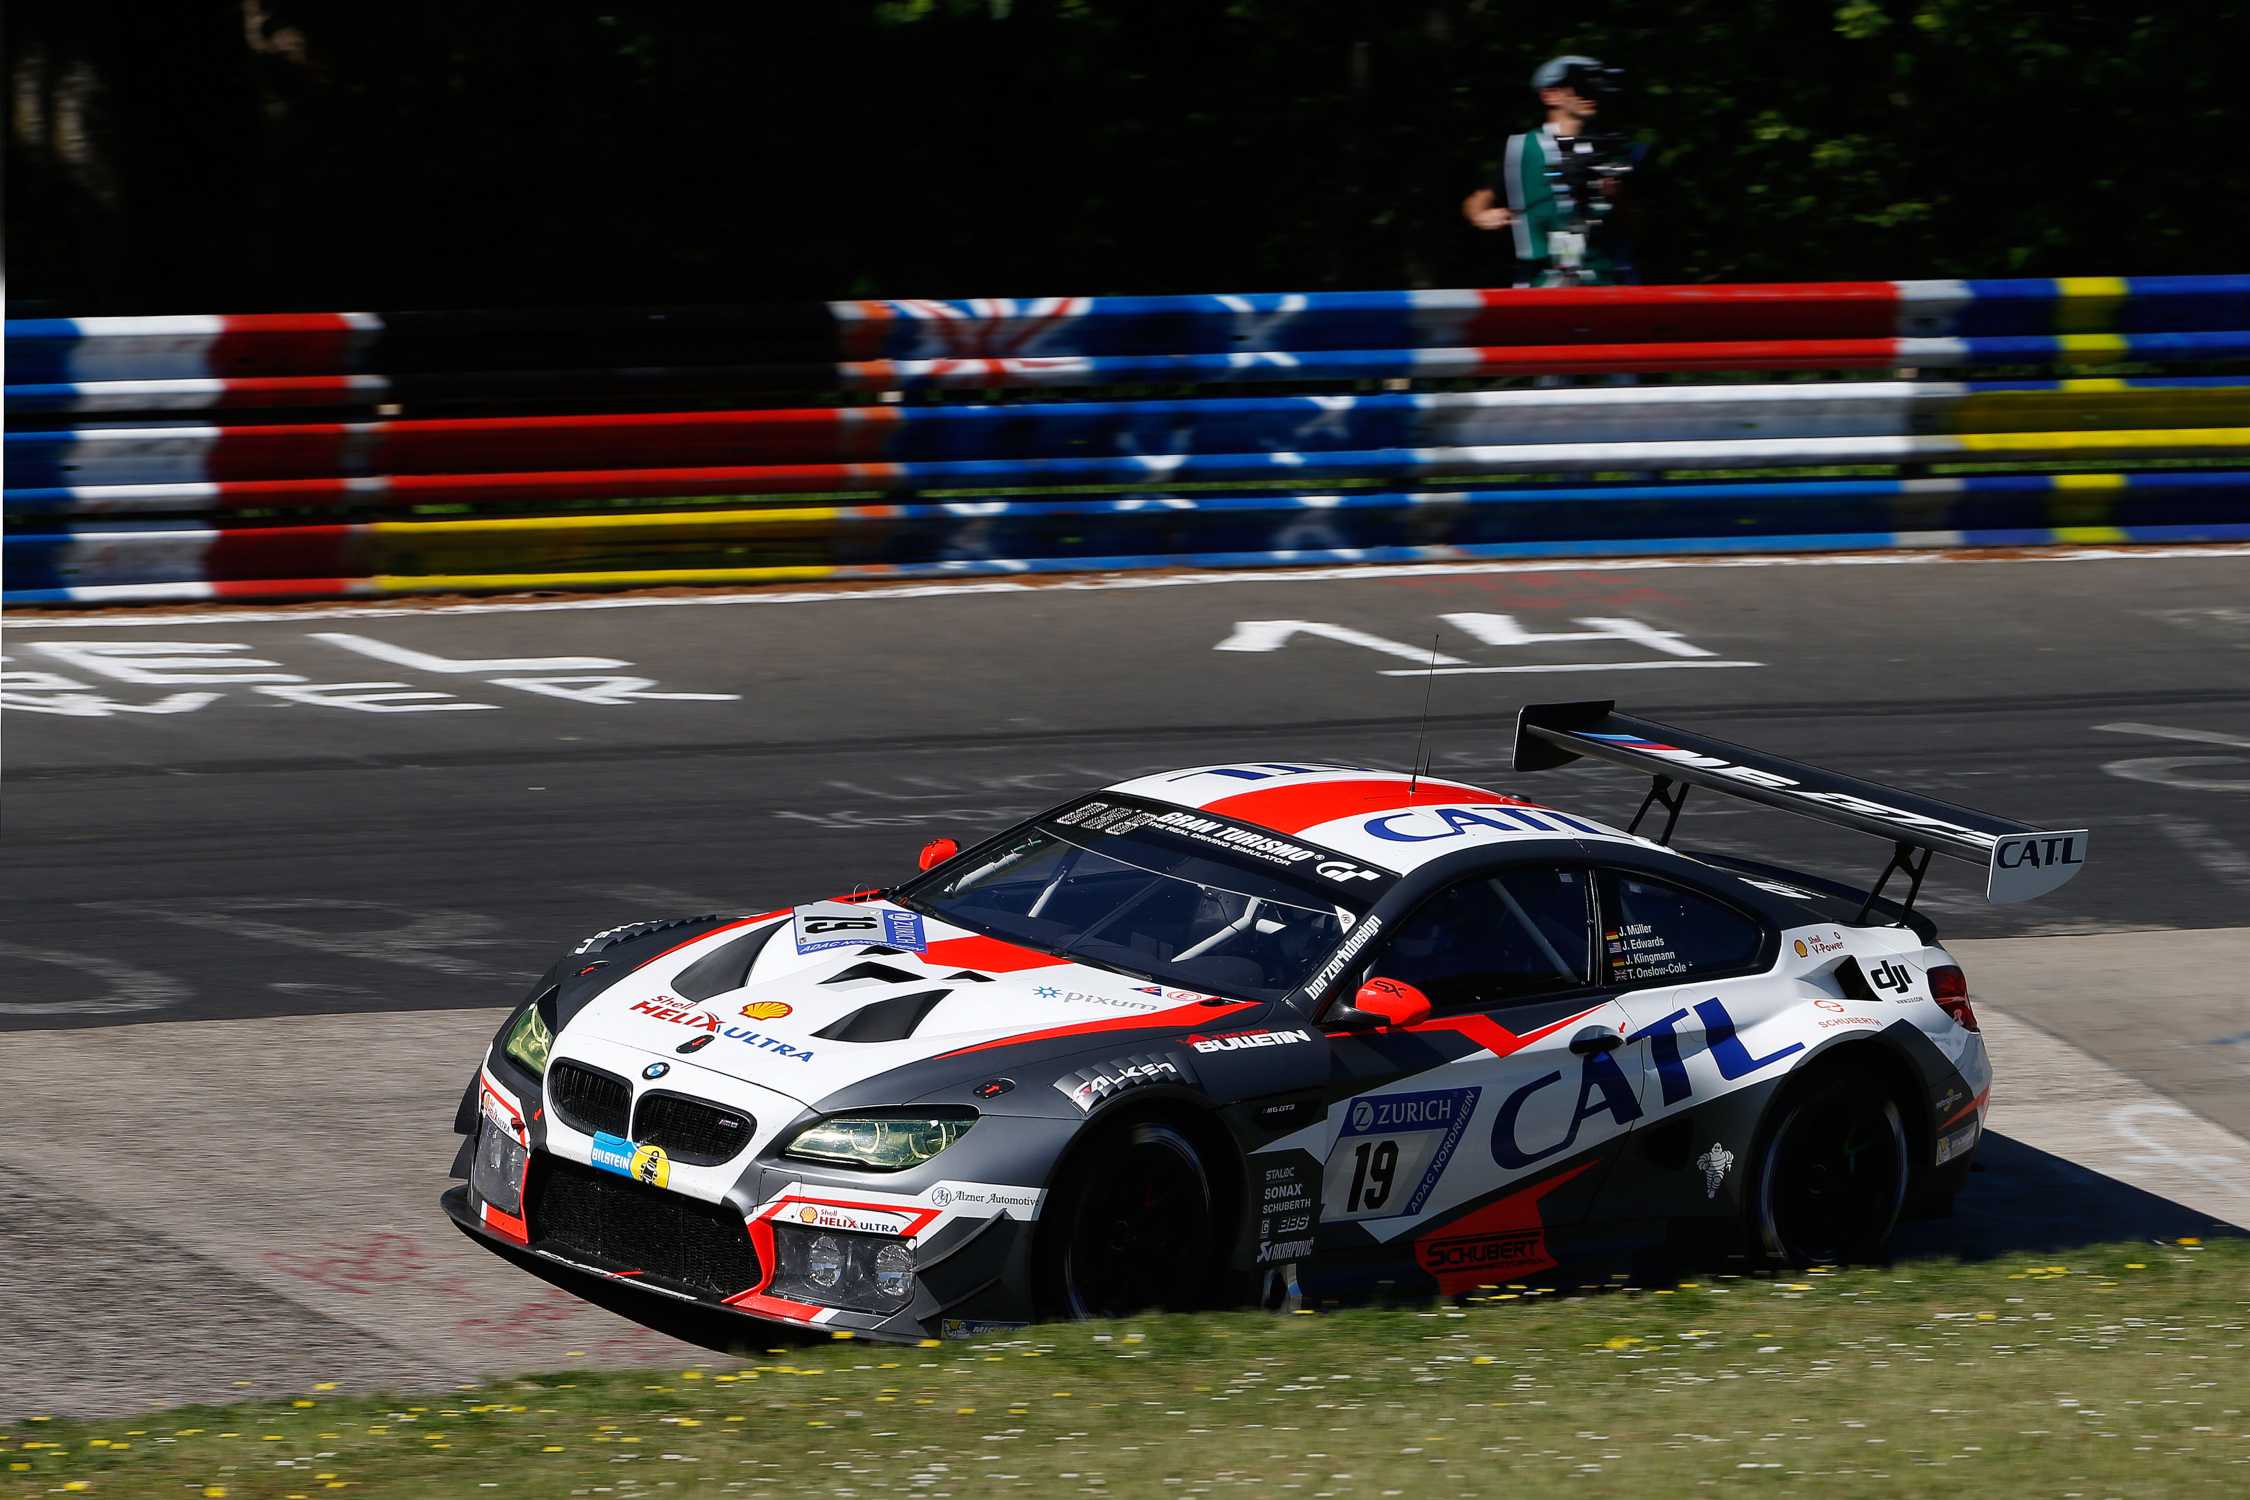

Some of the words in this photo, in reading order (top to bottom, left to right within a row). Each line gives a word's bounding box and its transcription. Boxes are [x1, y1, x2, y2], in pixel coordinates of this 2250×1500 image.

[1158, 811, 1224, 833] GRAN
[1215, 826, 1316, 862] TURISMO
[1167, 826, 1190, 836] REAL
[1190, 832, 1231, 848] DRIVING
[1231, 844, 1292, 867] SIMULATOR
[1997, 836, 2083, 869] CATL
[1618, 926, 1627, 937] J.
[1627, 923, 1652, 936] Müller
[1622, 940, 1630, 951] J.
[1631, 936, 1665, 950] Edwards
[1625, 954, 1633, 966] J.
[1633, 951, 1676, 965] Klingmann
[1636, 961, 1687, 978] Onslow-Cole
[651, 995, 700, 1010] Shell
[1064, 992, 1160, 1012] pixum
[629, 1001, 727, 1033] HELIX
[723, 1027, 814, 1062] ULTRA
[1818, 1017, 1884, 1029] SCHUBERTH
[1193, 1029, 1312, 1054] BULLETIN
[1491, 997, 1806, 1170] CATL
[1377, 1099, 1452, 1125] ZURICH
[592, 1148, 630, 1171] BILSTEIN
[1411, 1173, 1435, 1213] ADAC
[1433, 1090, 1476, 1173] NORDRHEIN
[1346, 1140, 1399, 1213] 19
[951, 1190, 985, 1203] Alzner
[1264, 1183, 1302, 1200] SONAX
[1262, 1198, 1312, 1215] SCHUBERTH
[818, 1215, 859, 1230] HELIX
[860, 1222, 899, 1233] ULTRA
